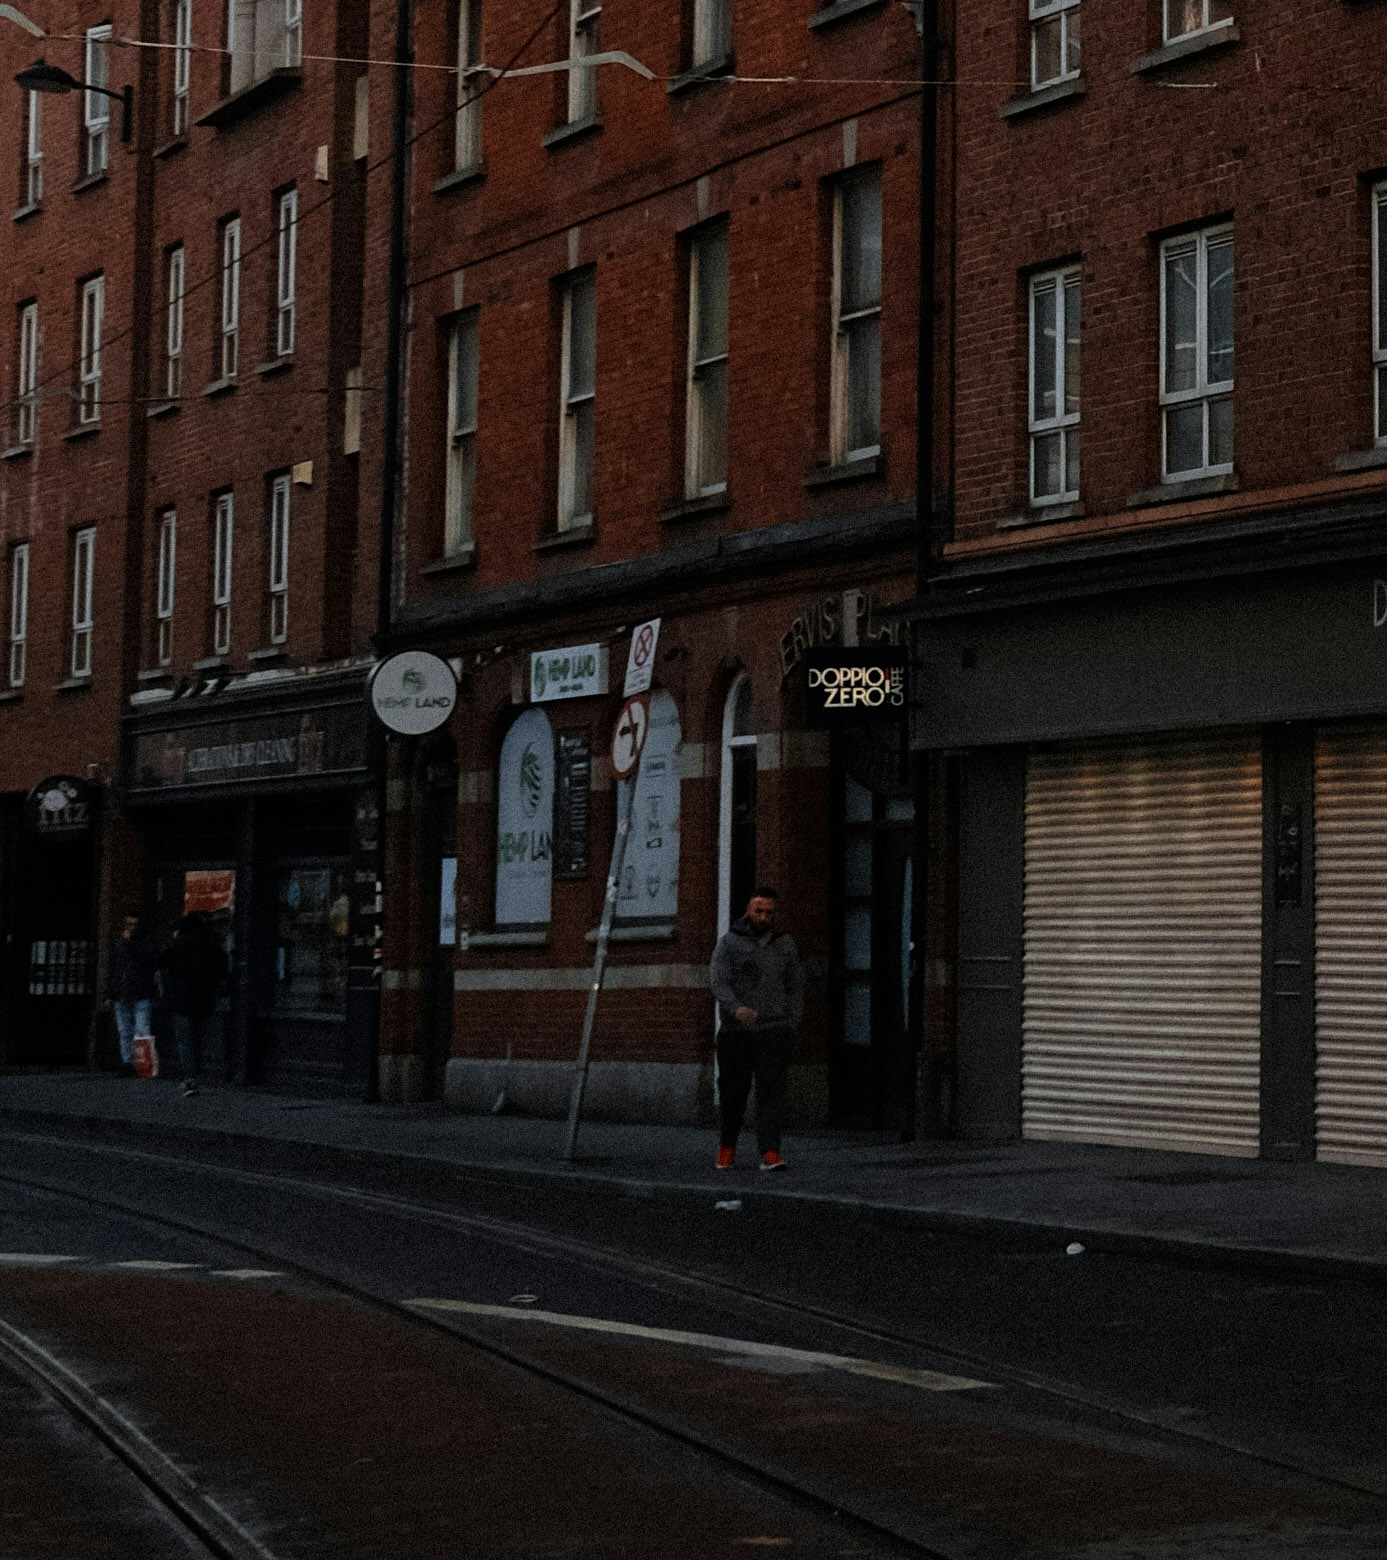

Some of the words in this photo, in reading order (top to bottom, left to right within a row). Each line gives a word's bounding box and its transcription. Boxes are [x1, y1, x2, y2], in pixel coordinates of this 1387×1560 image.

[808, 666, 885, 688] DOPPIO
[415, 696, 451, 709] LAND
[823, 686, 886, 708] ZERO
